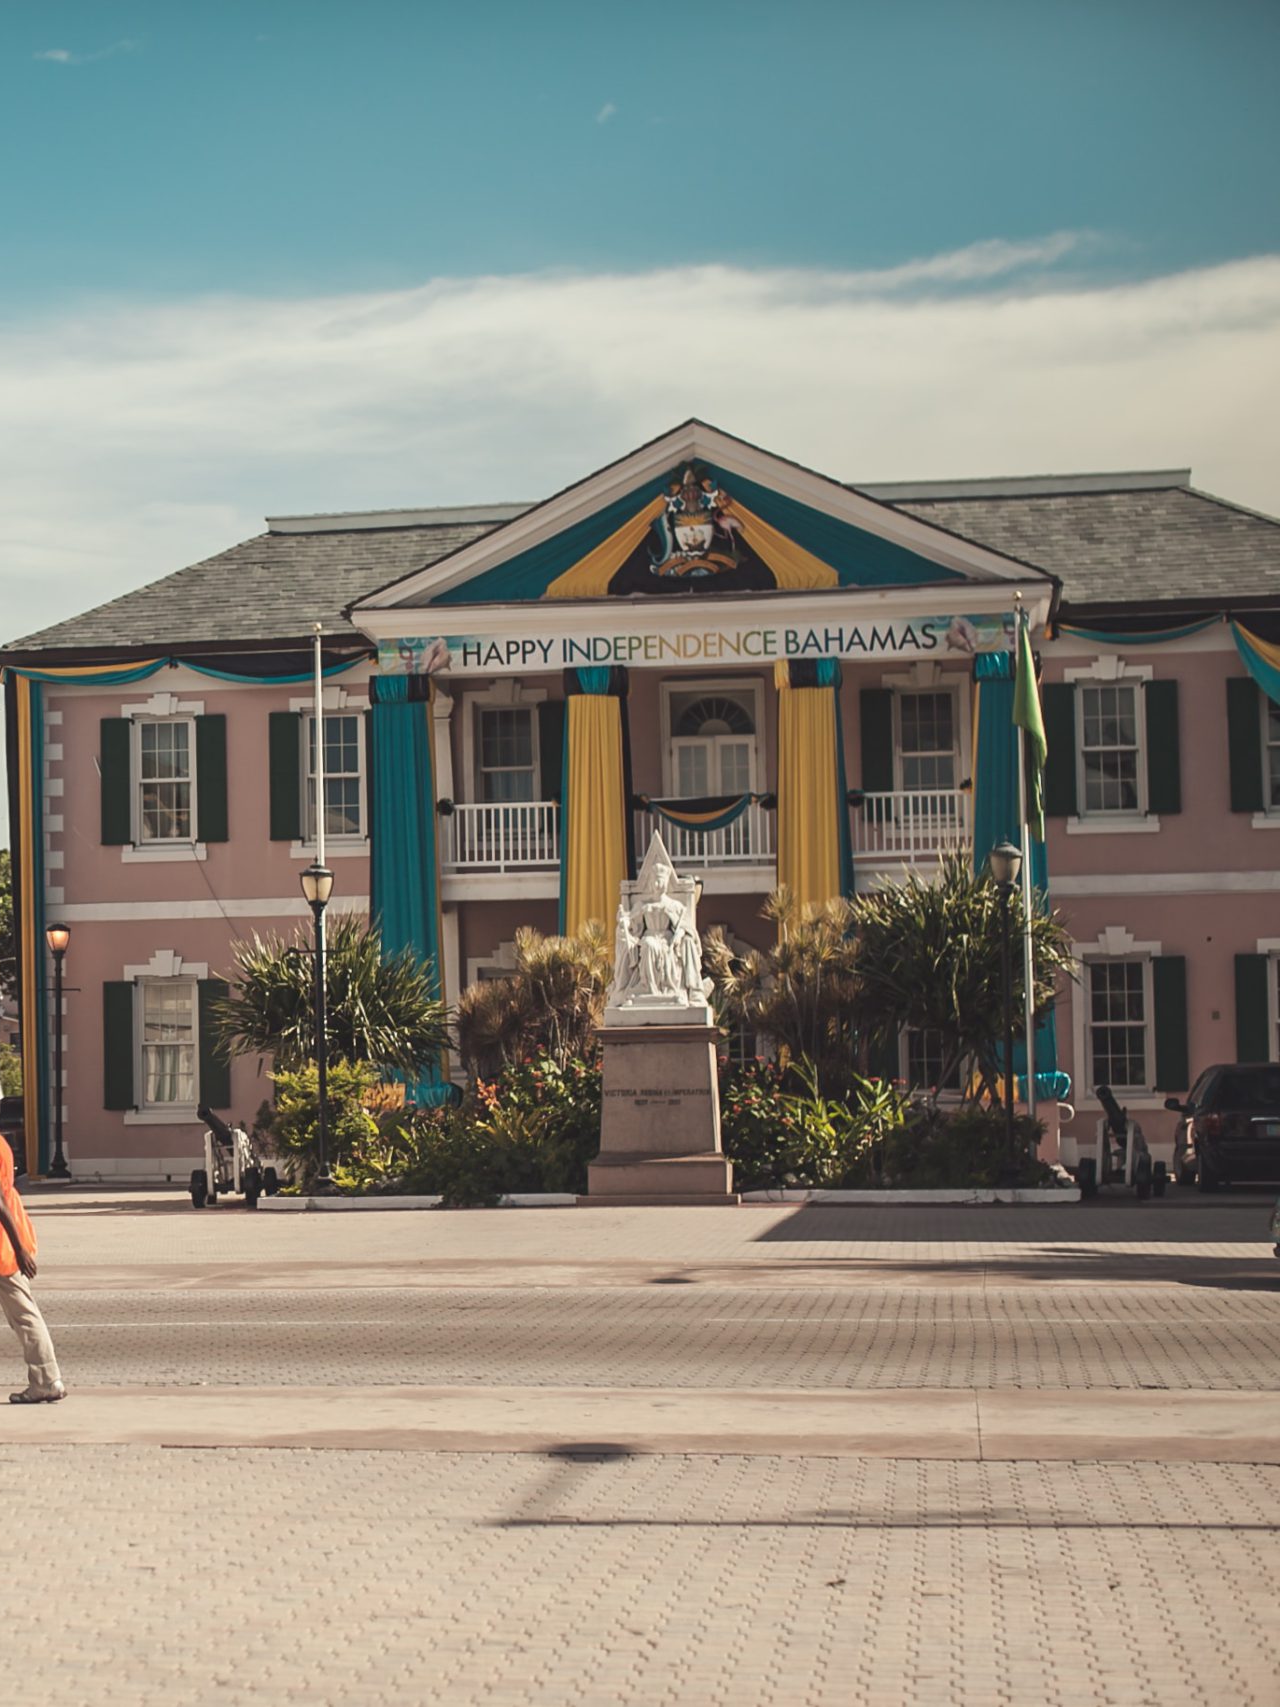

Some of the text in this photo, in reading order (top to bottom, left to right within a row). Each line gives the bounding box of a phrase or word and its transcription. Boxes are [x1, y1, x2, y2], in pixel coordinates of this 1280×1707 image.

[462, 623, 938, 667] HAPPY INDEPENDENCE BAHAMAS
